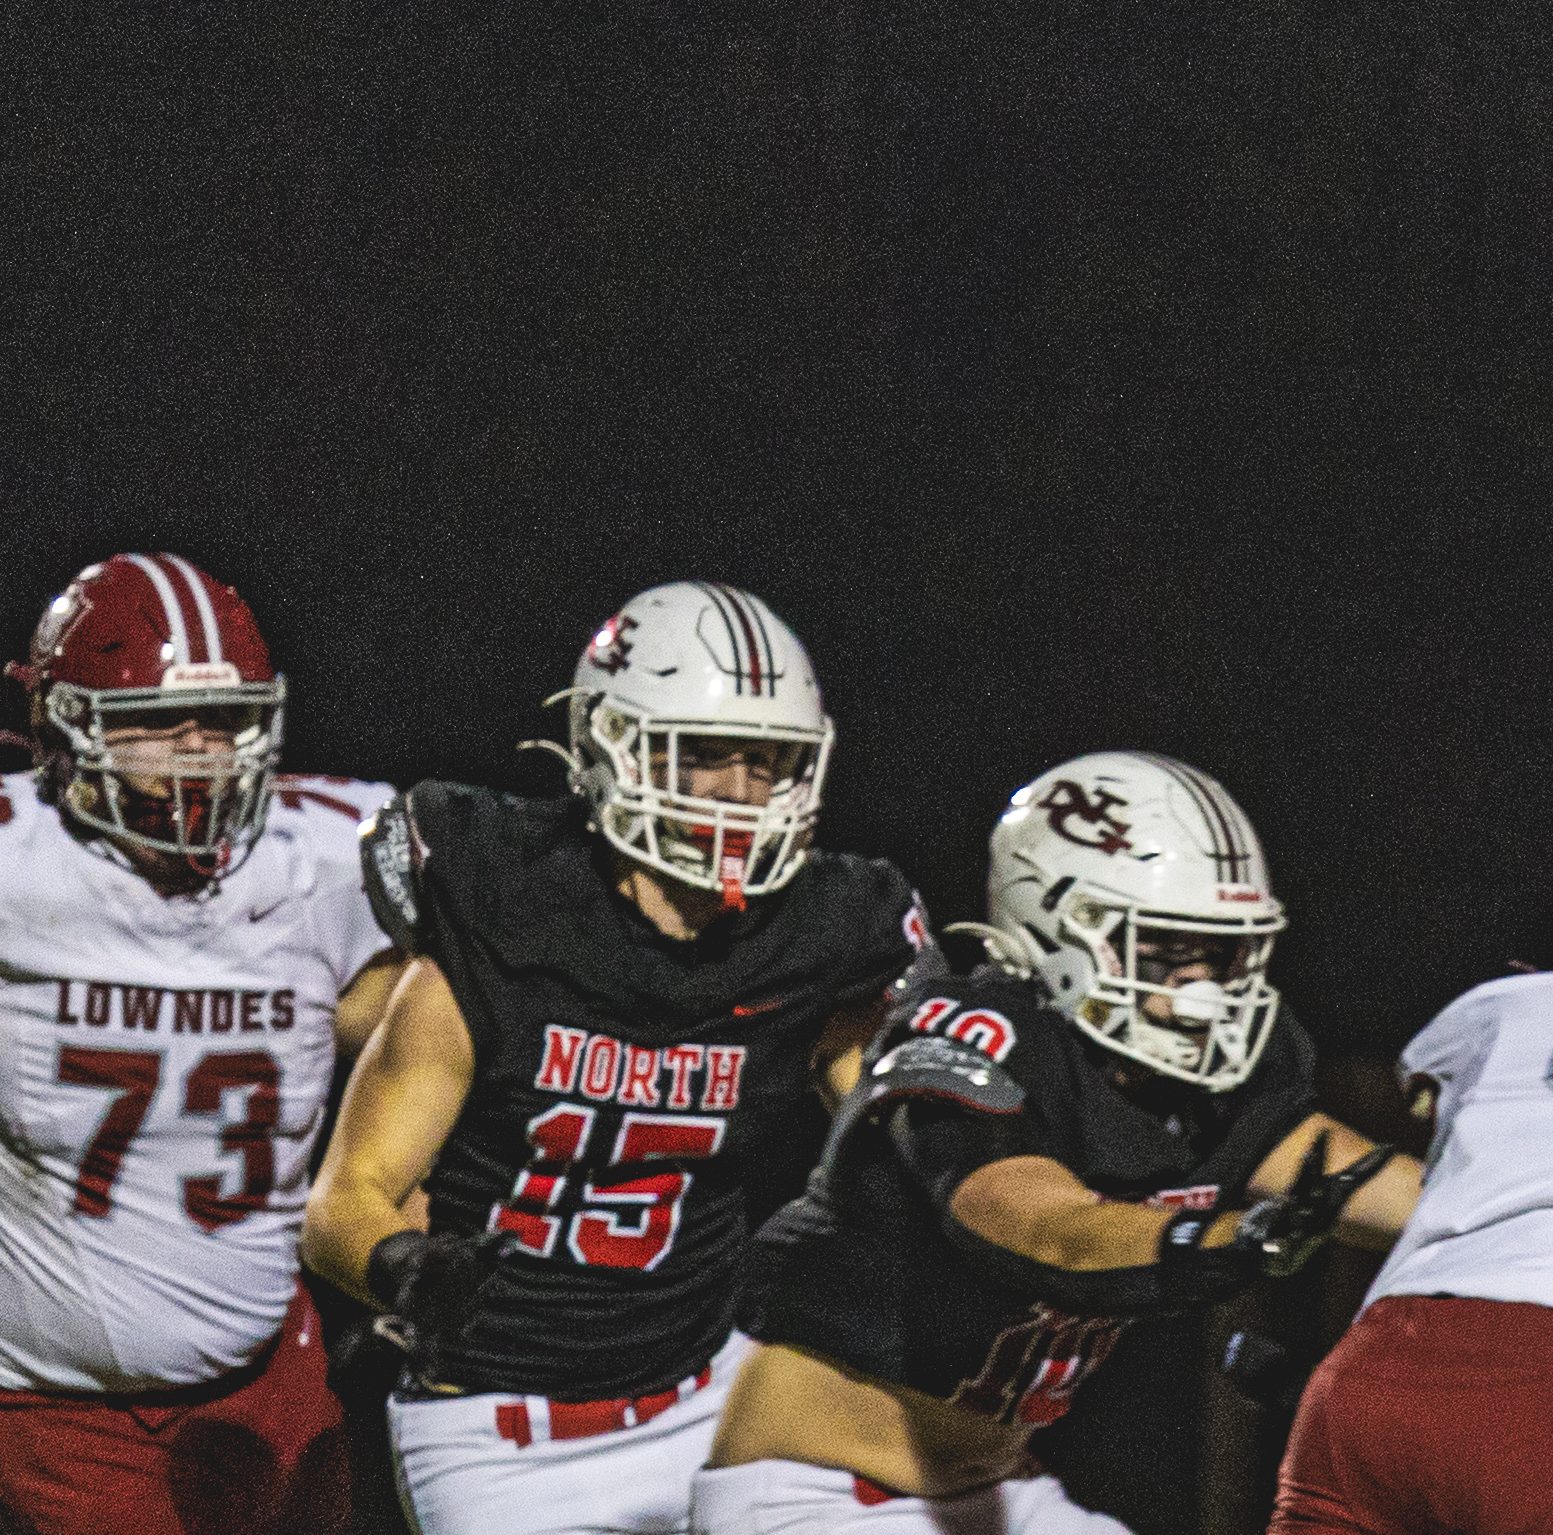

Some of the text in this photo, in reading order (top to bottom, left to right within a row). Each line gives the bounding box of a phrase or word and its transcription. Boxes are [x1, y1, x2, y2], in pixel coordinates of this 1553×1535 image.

[56, 978, 296, 1034] LOWNDES
[534, 1023, 746, 1112] NORTH
[56, 1043, 284, 1238] 73
[484, 1101, 728, 1273] 15
